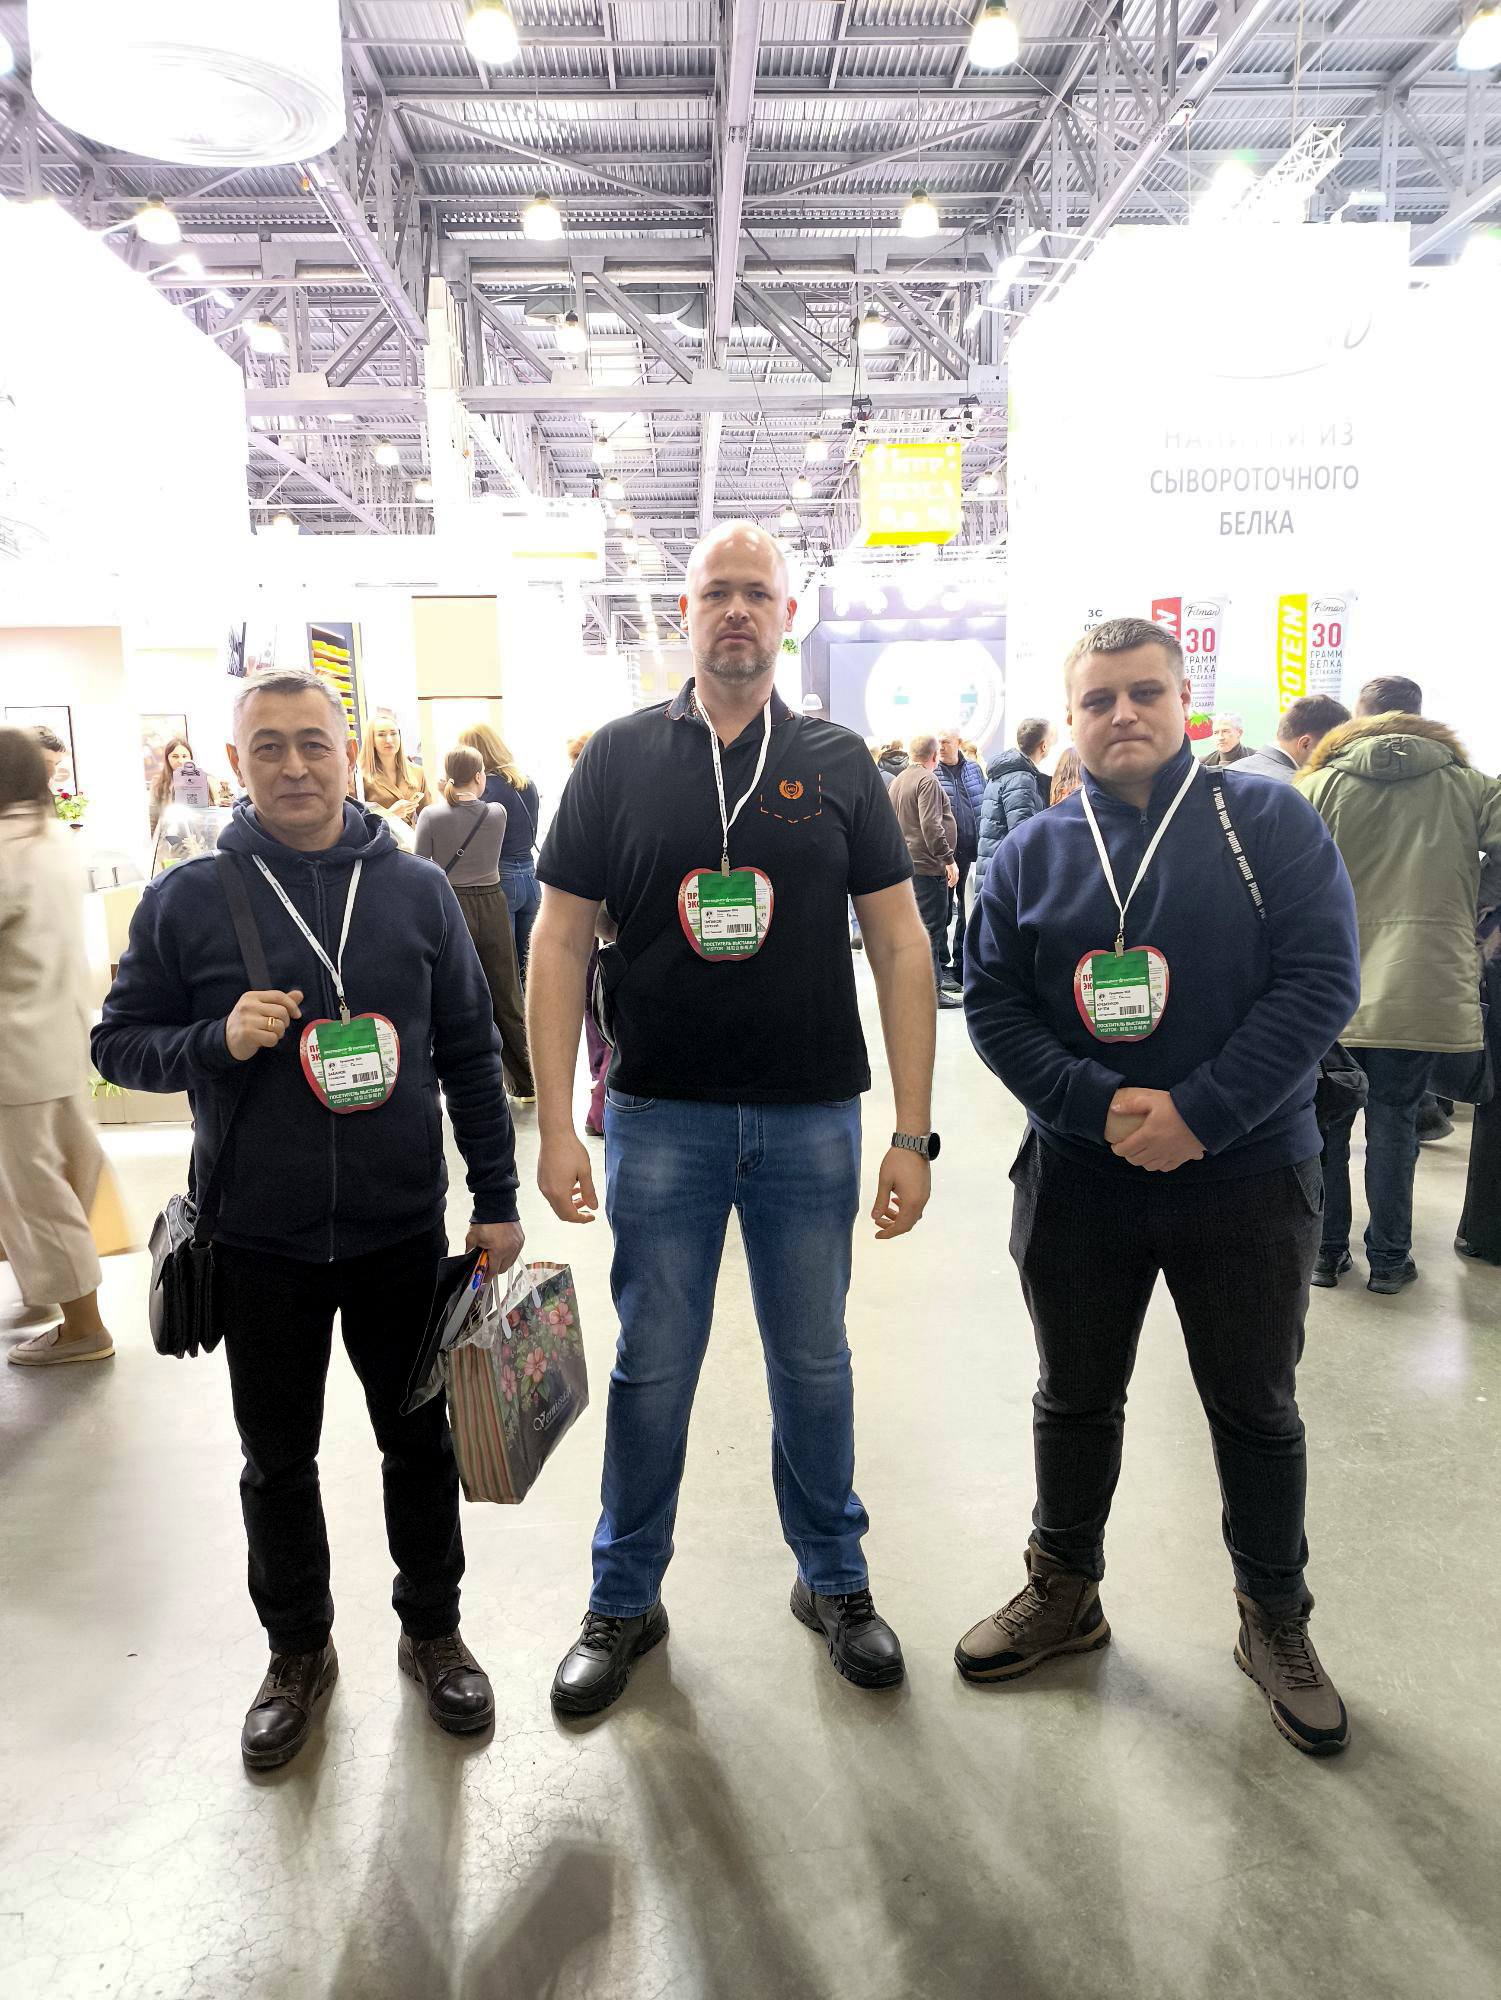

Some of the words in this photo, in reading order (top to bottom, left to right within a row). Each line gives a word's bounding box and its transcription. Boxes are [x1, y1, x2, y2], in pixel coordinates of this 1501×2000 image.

[1150, 465, 1360, 494] СЫВОРОТОЧНОГО
[1219, 510, 1295, 536] БЕЛКА
[1186, 627, 1216, 653] 30
[1311, 622, 1341, 648] 30
[1281, 604, 1303, 711] ROTEIN
[1310, 650, 1343, 658] ГРАММ
[1310, 659, 1342, 669] БЕЛКА
[1226, 830, 1243, 854] PUMA
[1236, 855, 1254, 880] PUMA
